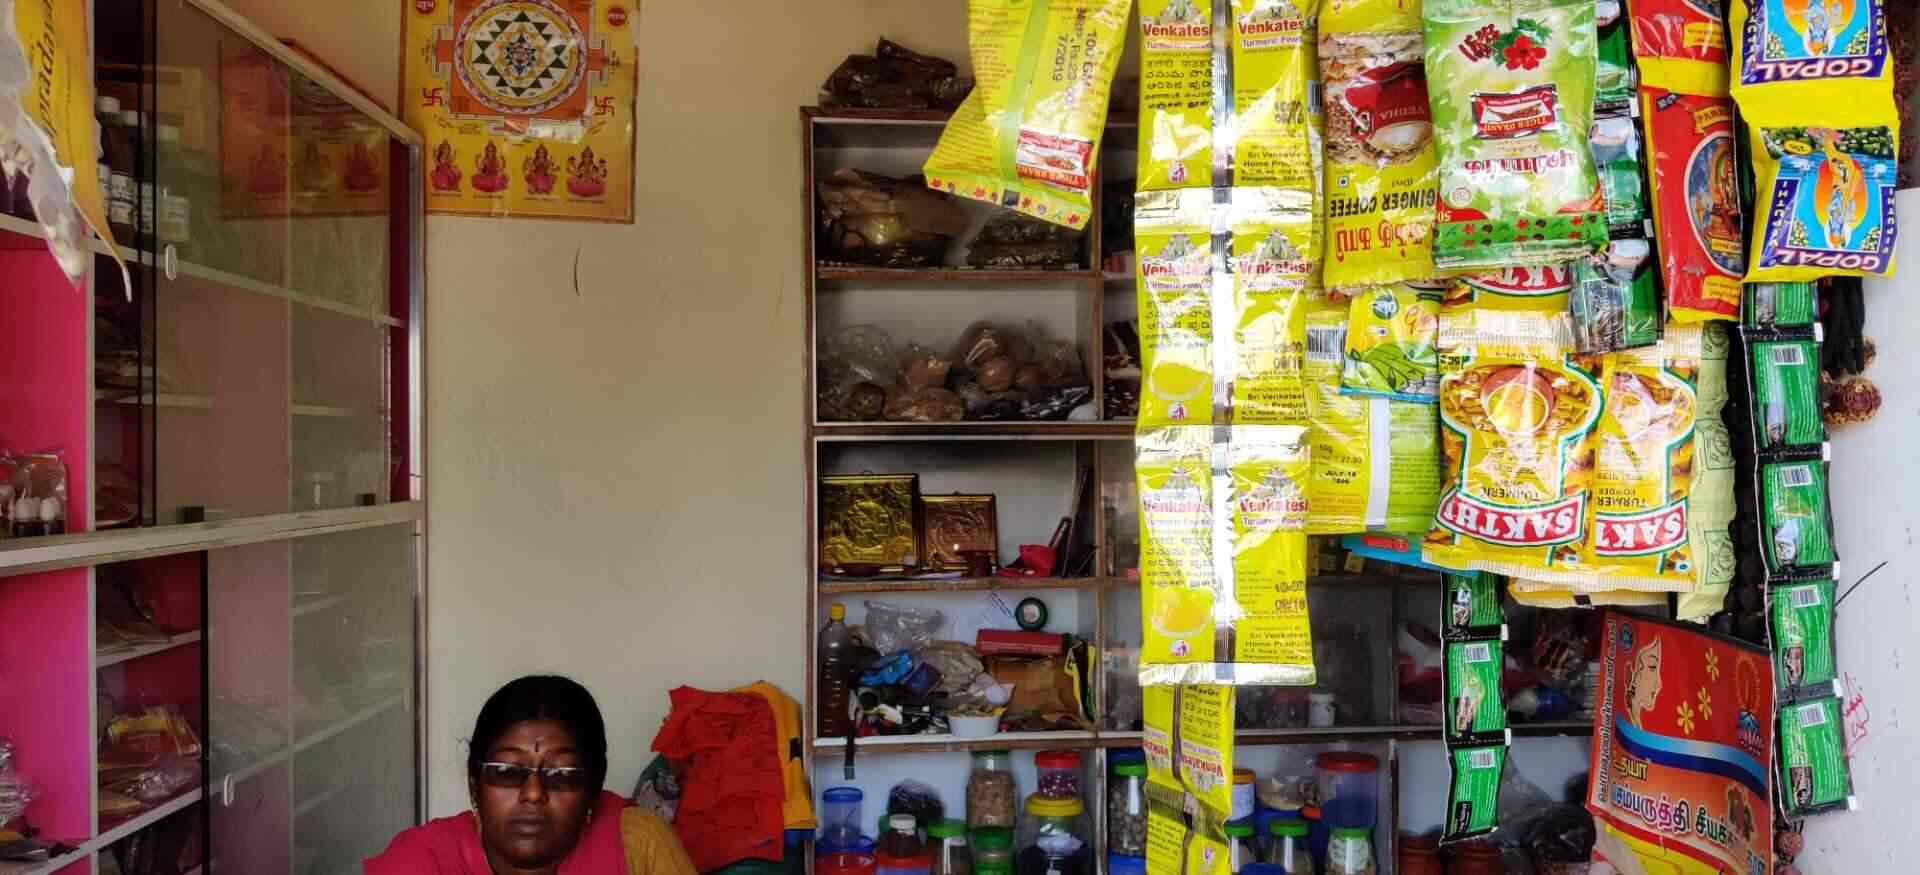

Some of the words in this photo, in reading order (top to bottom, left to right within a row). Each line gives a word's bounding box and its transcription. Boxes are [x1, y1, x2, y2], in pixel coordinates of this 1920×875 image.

[1756, 59, 1874, 81] GOPAL
[1328, 196, 1378, 218] COFFEE
[1382, 187, 1436, 211] GINGER
[1883, 187, 1897, 254] VIPUTHI
[1775, 249, 1880, 271] GOPAL
